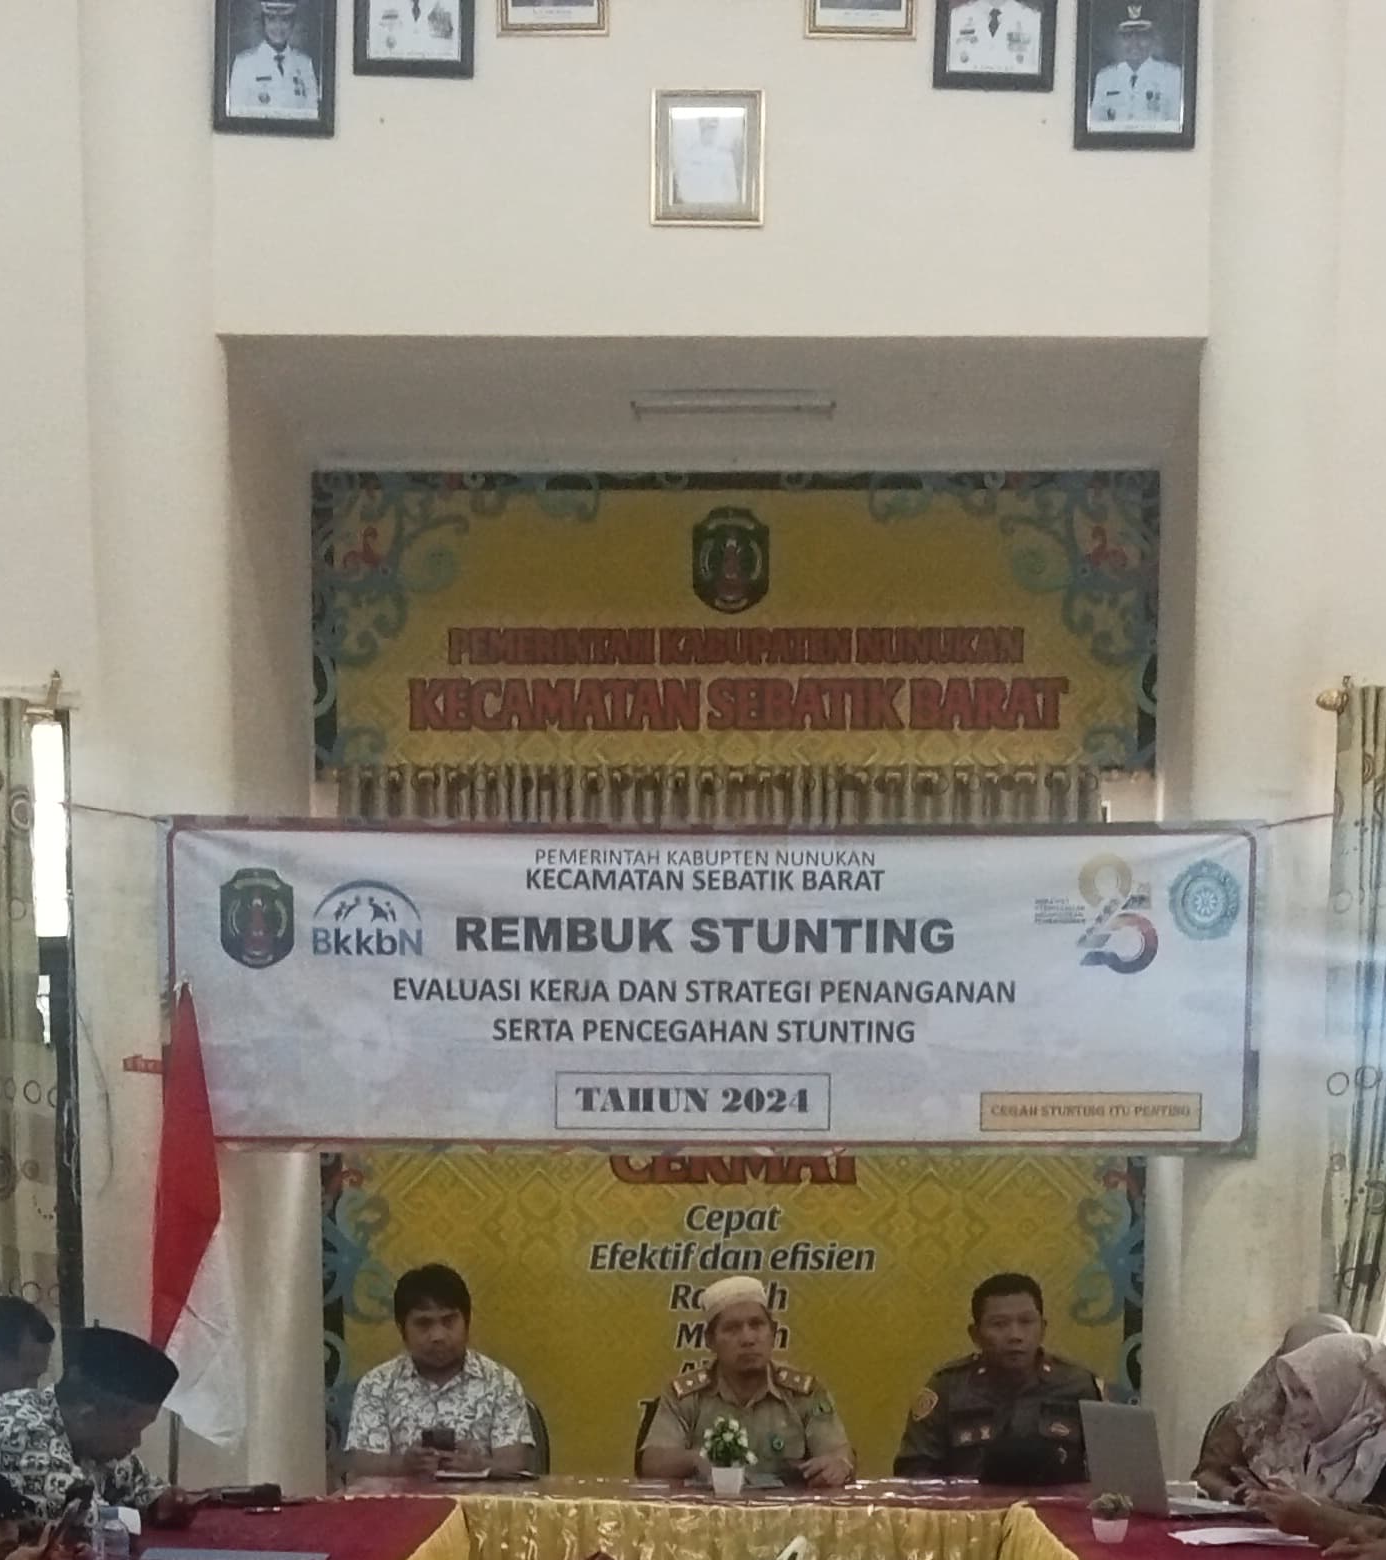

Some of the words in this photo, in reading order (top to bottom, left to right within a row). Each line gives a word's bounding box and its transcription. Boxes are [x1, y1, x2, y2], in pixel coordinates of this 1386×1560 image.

[449, 627, 655, 664] PEMERINTAH
[856, 627, 1024, 664] NUNUKAN
[410, 678, 701, 731] KECAMATAN
[707, 678, 906, 731] SEBATIK
[910, 676, 1069, 730] BARAT
[535, 849, 659, 865] PEMERINTAH
[667, 850, 768, 866] KABUPTEN
[776, 850, 875, 866] NUNUKAN
[526, 868, 684, 890] KECAMATAN
[692, 869, 794, 891] SEBATIK
[802, 870, 885, 891] BARAT
[313, 927, 423, 956] BkkbN
[455, 916, 674, 953] REMBUK
[690, 917, 955, 954] STUNTING
[393, 977, 520, 1001] EVALUASI
[530, 979, 610, 1002] KERJA
[619, 980, 677, 1002] DAN
[685, 980, 811, 1003] STRATEGI
[820, 980, 1016, 1004] PENANGANAN
[492, 1018, 574, 1042] SERTA
[583, 1018, 768, 1043] PENCEGAHAN
[777, 1020, 915, 1044] STUNTING
[575, 1087, 709, 1112] TAHUN
[721, 1087, 809, 1113] 2024
[685, 1204, 781, 1238] Cepat
[589, 1242, 697, 1271] Efektif
[699, 1242, 762, 1271] dan
[770, 1243, 875, 1271] efisien
